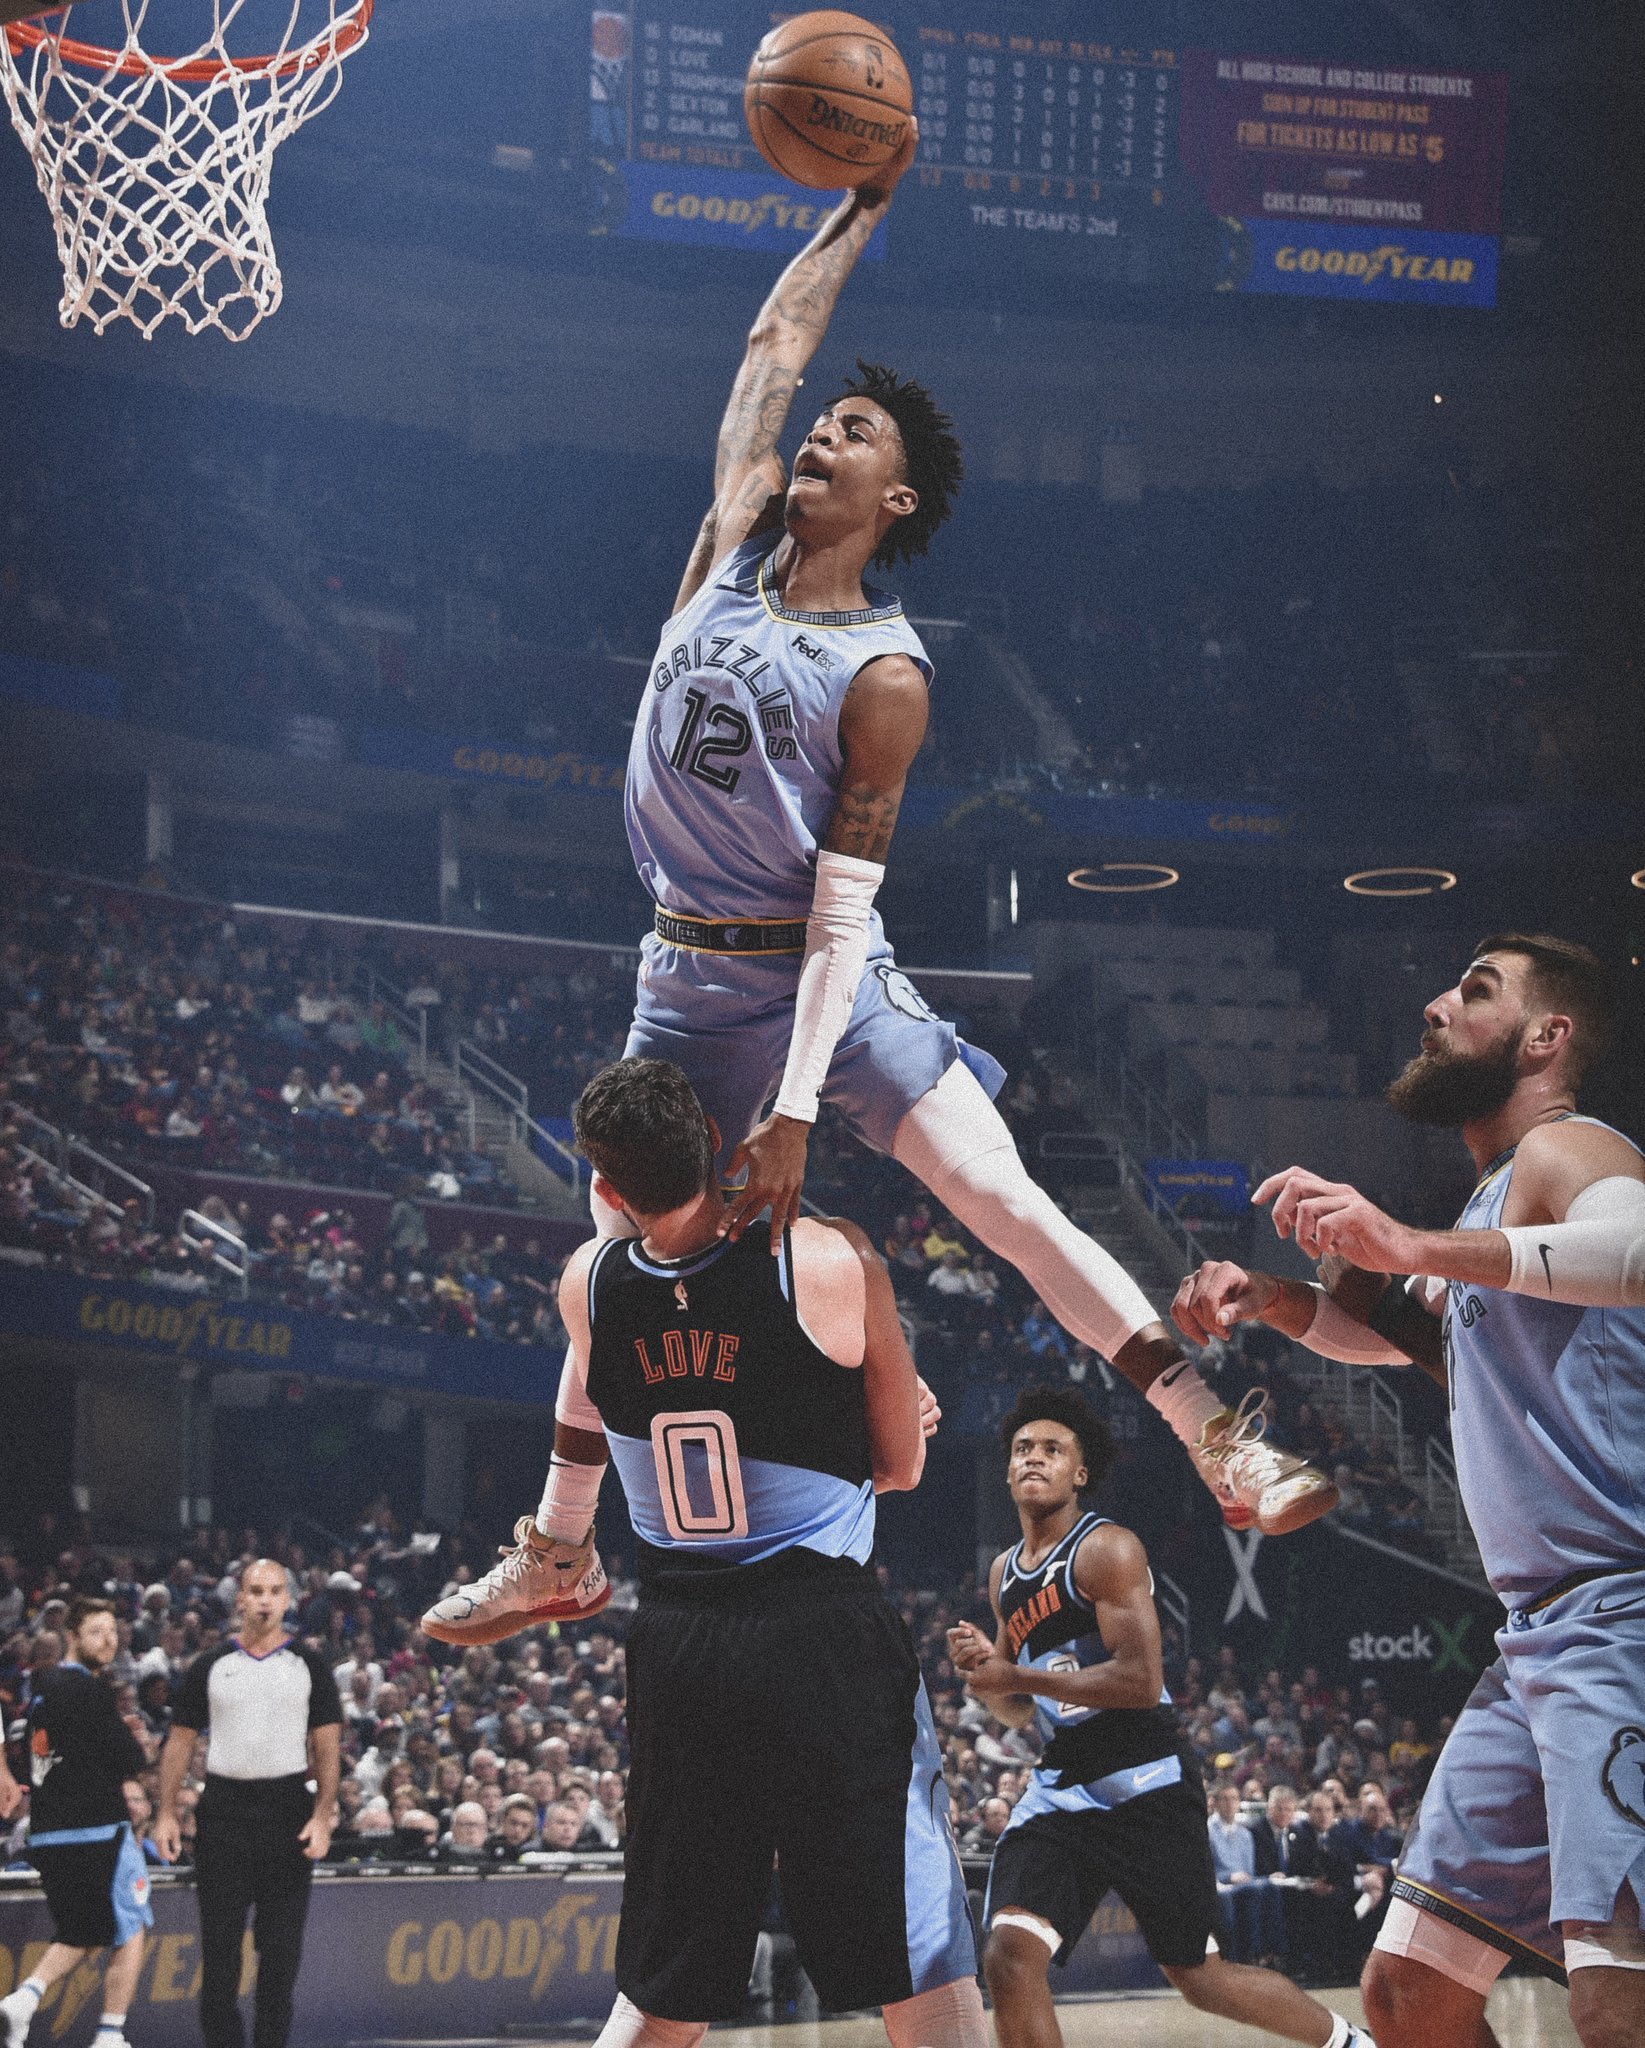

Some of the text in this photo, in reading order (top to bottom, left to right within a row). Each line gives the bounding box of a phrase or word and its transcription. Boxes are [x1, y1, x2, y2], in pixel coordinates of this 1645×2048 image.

[669, 49, 709, 68] LOVE
[1217, 60, 1239, 79] ALL
[1274, 64, 1323, 86] SCHOOL
[1326, 68, 1352, 88] AND
[1353, 71, 1406, 92] COLLEGE
[1408, 75, 1473, 97] STUDENTS
[671, 70, 745, 94] THOMPSO
[1237, 120, 1267, 144] FOR
[1270, 123, 1333, 149] TICKETS
[1337, 129, 1358, 151] AS
[1360, 130, 1394, 154] LOW
[1398, 133, 1418, 156] AS
[971, 205, 1007, 227] THE
[1013, 208, 1082, 233] TEAM'S
[1274, 245, 1474, 284] GOODYEAR
[791, 634, 834, 672] FedEx
[653, 637, 797, 761] GRIZZLIES
[670, 687, 753, 795] 12
[454, 745, 624, 790] GOODYEA
[80, 1294, 293, 1358] GOODYEAR
[634, 1329, 740, 1385] LOVE
[650, 1410, 749, 1541] 0
[386, 1894, 621, 2002] GOODY
